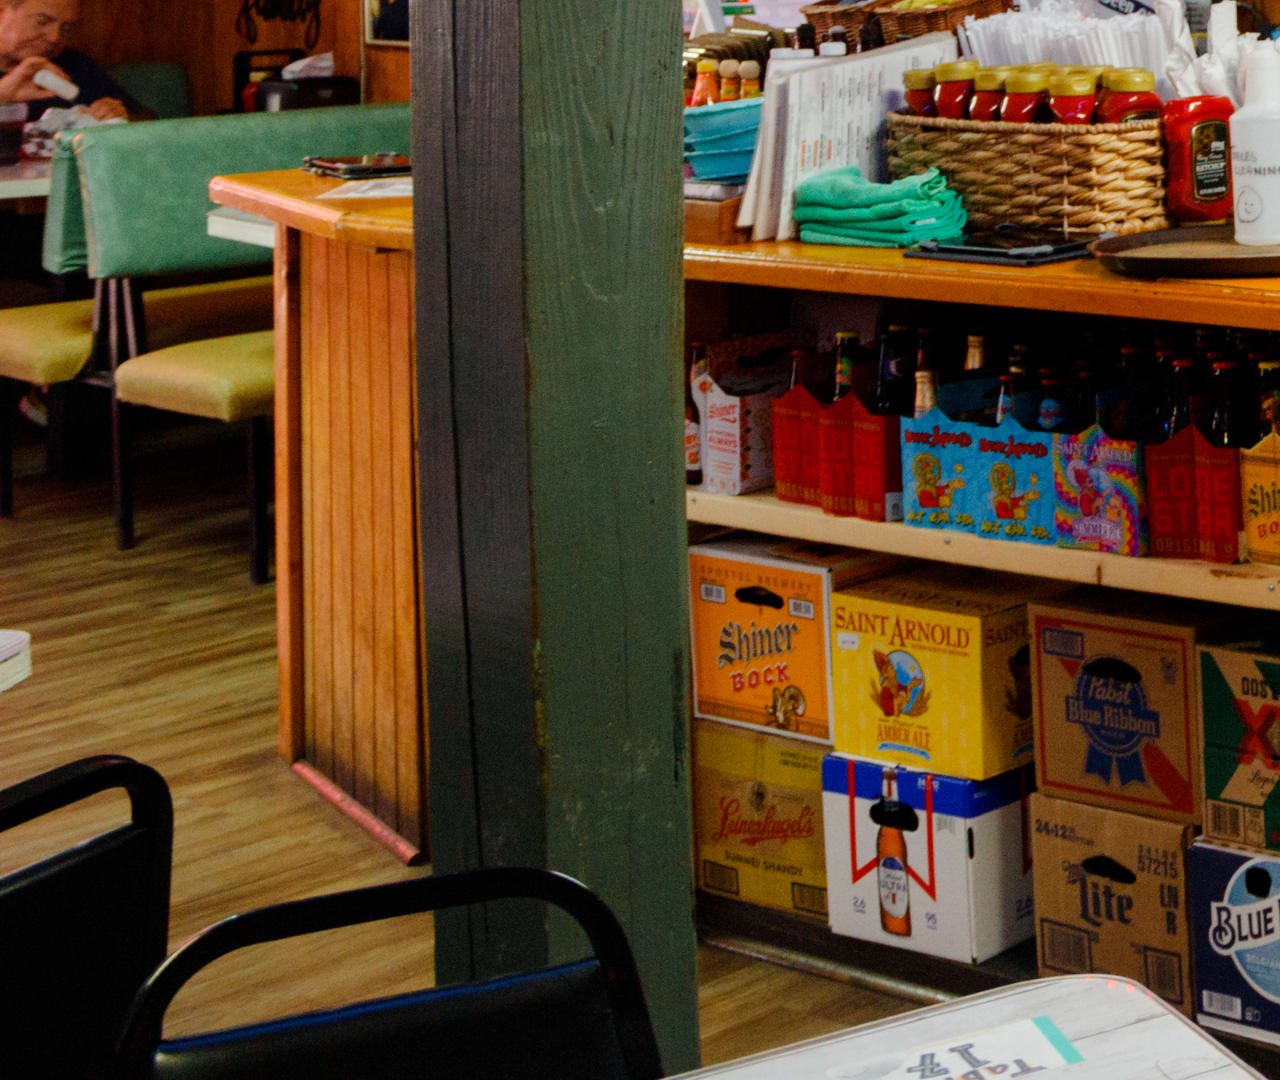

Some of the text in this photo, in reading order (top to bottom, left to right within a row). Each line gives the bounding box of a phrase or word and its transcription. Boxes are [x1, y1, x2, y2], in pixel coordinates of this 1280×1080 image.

[717, 620, 800, 669] Shiner
[835, 605, 970, 650] SAINT ARNOLD
[730, 663, 791, 693] BOCK
[1089, 676, 1132, 705] Pabst
[1241, 676, 1268, 698] DOS
[1069, 700, 1157, 735] Blue Ribbon
[876, 723, 932, 752] AMBER ALE
[1079, 873, 1133, 927] Lite
[1212, 905, 1275, 950] BLUE
